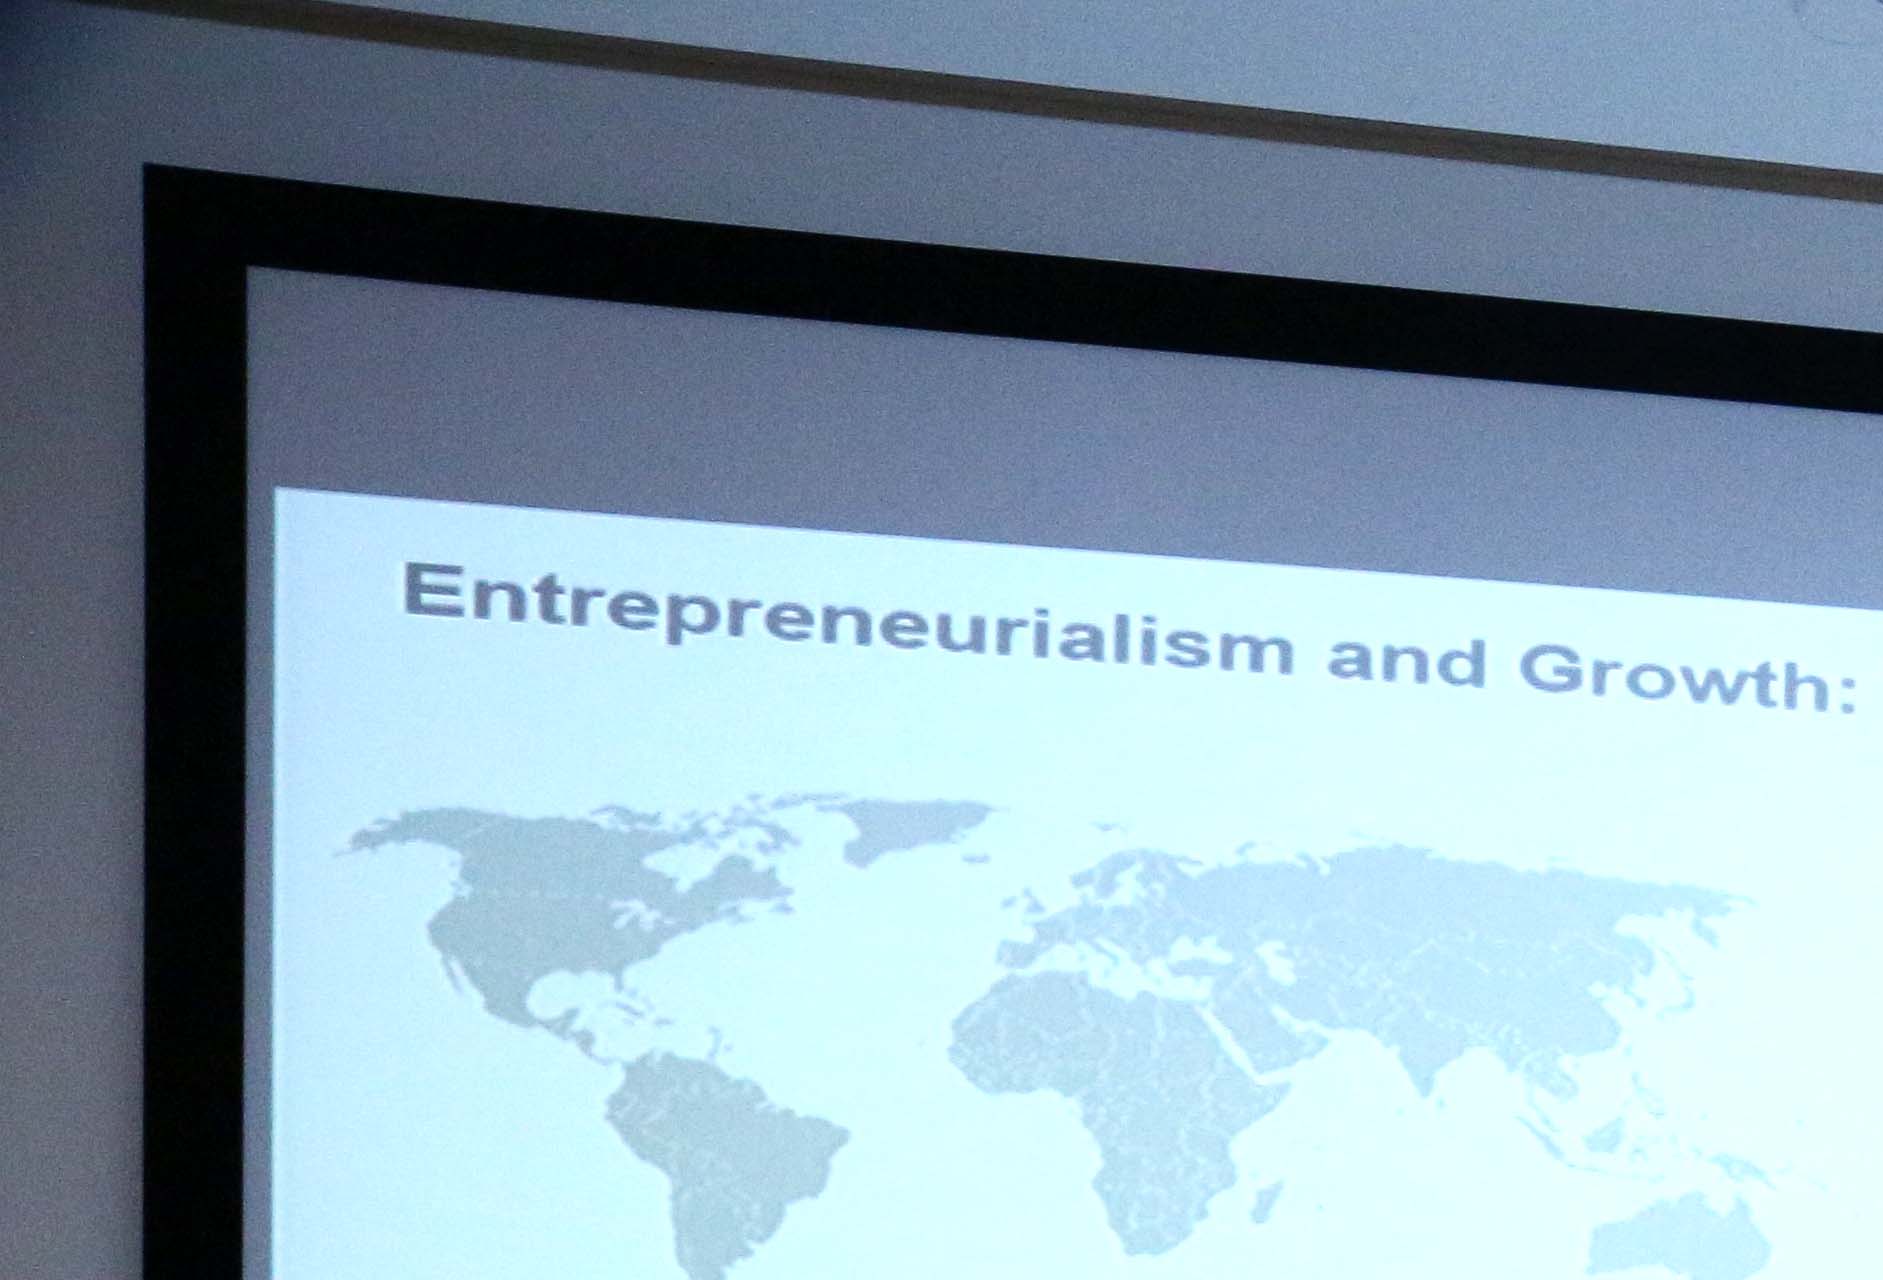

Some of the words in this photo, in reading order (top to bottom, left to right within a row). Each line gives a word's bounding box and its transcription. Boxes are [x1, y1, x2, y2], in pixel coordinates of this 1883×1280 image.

[404, 561, 1296, 676] Entrepreneurialism
[1327, 637, 1487, 690] and
[1518, 643, 1857, 715] Growth:
